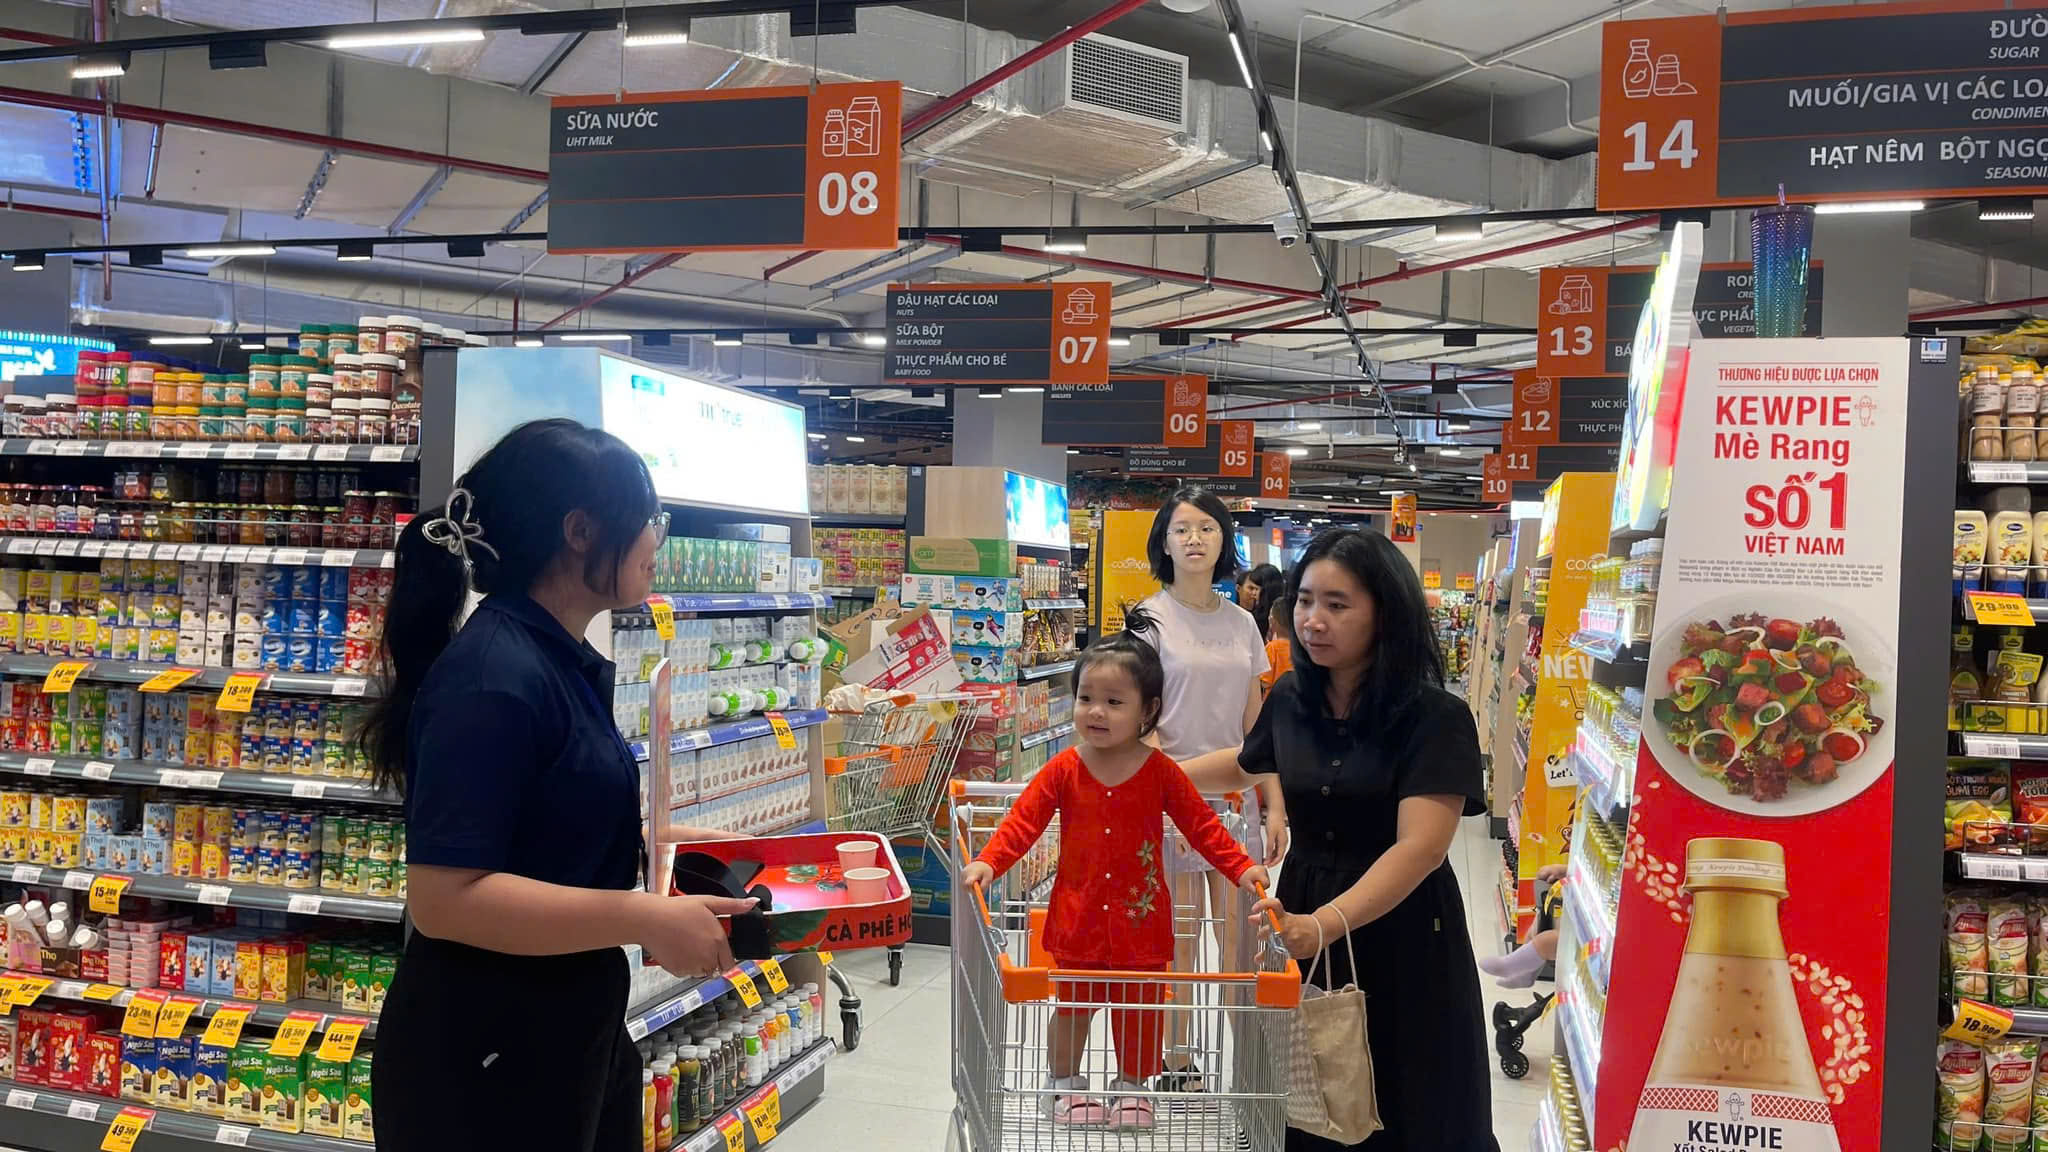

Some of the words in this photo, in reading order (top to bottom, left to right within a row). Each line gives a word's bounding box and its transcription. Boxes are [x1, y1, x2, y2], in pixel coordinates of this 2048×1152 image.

[1988, 46, 2040, 59] SUGAR
[1788, 77, 1917, 109] MUỐI/GIA
[1925, 82, 1949, 105] VỊ
[1956, 75, 2006, 100] CÁC
[2013, 78, 2048, 98] LO
[566, 111, 603, 130] SỮA
[606, 107, 659, 129] NƯỚC
[566, 136, 587, 147] UHT
[588, 135, 614, 146] MILK
[1622, 119, 1699, 172] 14
[1810, 146, 1861, 169] HẠT
[1866, 139, 1924, 164] NÊM
[1940, 135, 1991, 164] BỘT
[818, 171, 879, 216] 08
[896, 293, 921, 307] ĐẬU
[924, 295, 946, 307] HẠT
[948, 292, 970, 306] CÁC
[972, 294, 999, 307] LOẠI
[896, 323, 919, 336] SỮA
[922, 323, 945, 338] BỘT
[1549, 325, 1593, 356] 13
[895, 354, 927, 367] THỰC
[929, 352, 963, 366] PHẨM
[966, 354, 990, 366] CHO
[993, 352, 1008, 366] BÉ
[1059, 336, 1098, 364] 07
[1614, 342, 1633, 357] BÁ
[1718, 367, 1761, 381] THƯƠNG
[1764, 366, 1789, 383] HIỆU
[1792, 367, 1821, 384] ĐƯỢC
[1824, 367, 1846, 384] LỰA
[1848, 368, 1879, 384] CHỌN
[1520, 410, 1552, 432] 12
[1715, 396, 1852, 426] KEWPIE
[1169, 413, 1198, 433] 06
[1578, 424, 1606, 434] THỰC
[1608, 424, 1622, 432] PH
[1224, 450, 1246, 466] 05
[1714, 432, 1760, 460] Mè
[1770, 432, 1850, 467] Rang
[1507, 453, 1530, 470] 11
[1264, 476, 1283, 490] 04
[1487, 479, 1507, 493] 10
[1744, 531, 1790, 558] VIỆT
[1796, 536, 1845, 556] NAM
[826, 918, 853, 942] CÀ
[859, 912, 894, 939] PHÊ
[1688, 1120, 1783, 1150] KEWPIE
